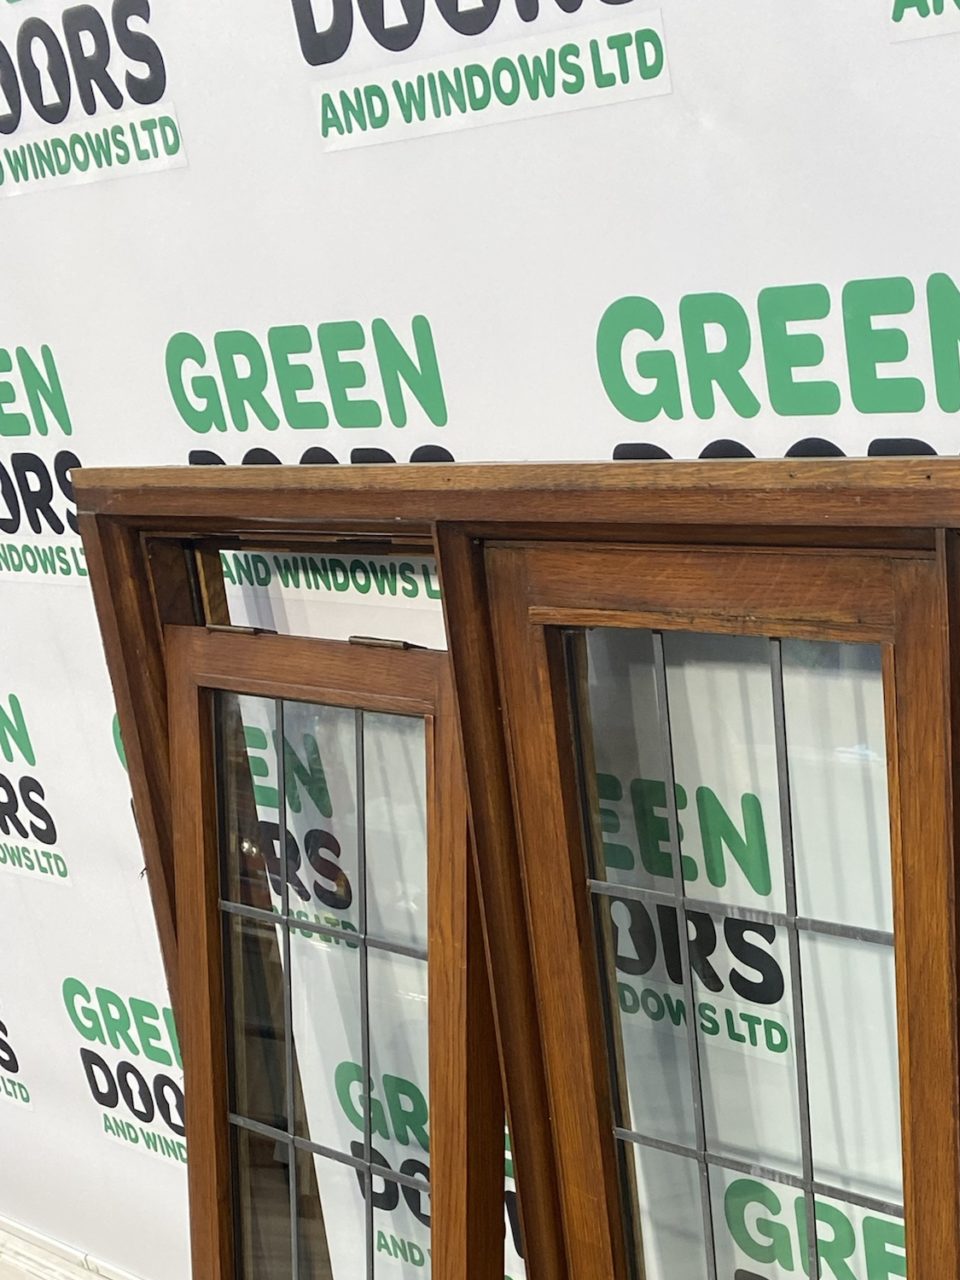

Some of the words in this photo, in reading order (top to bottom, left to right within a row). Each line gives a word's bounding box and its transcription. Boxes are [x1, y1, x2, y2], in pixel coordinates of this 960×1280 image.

[321, 84, 389, 138] AND
[392, 47, 585, 124] WINDOWS
[589, 28, 664, 88] LTD
[4, 125, 131, 183] WINDOWS
[129, 116, 180, 161] LTD
[165, 315, 448, 433] GREEN
[221, 552, 272, 587] AND
[273, 555, 419, 598] WINDOWS
[33, 849, 68, 878] LTD
[725, 1009, 788, 1053] LTD
[5, 1075, 30, 1103] LTD
[103, 1113, 139, 1144] AND
[376, 1230, 425, 1267] AND
